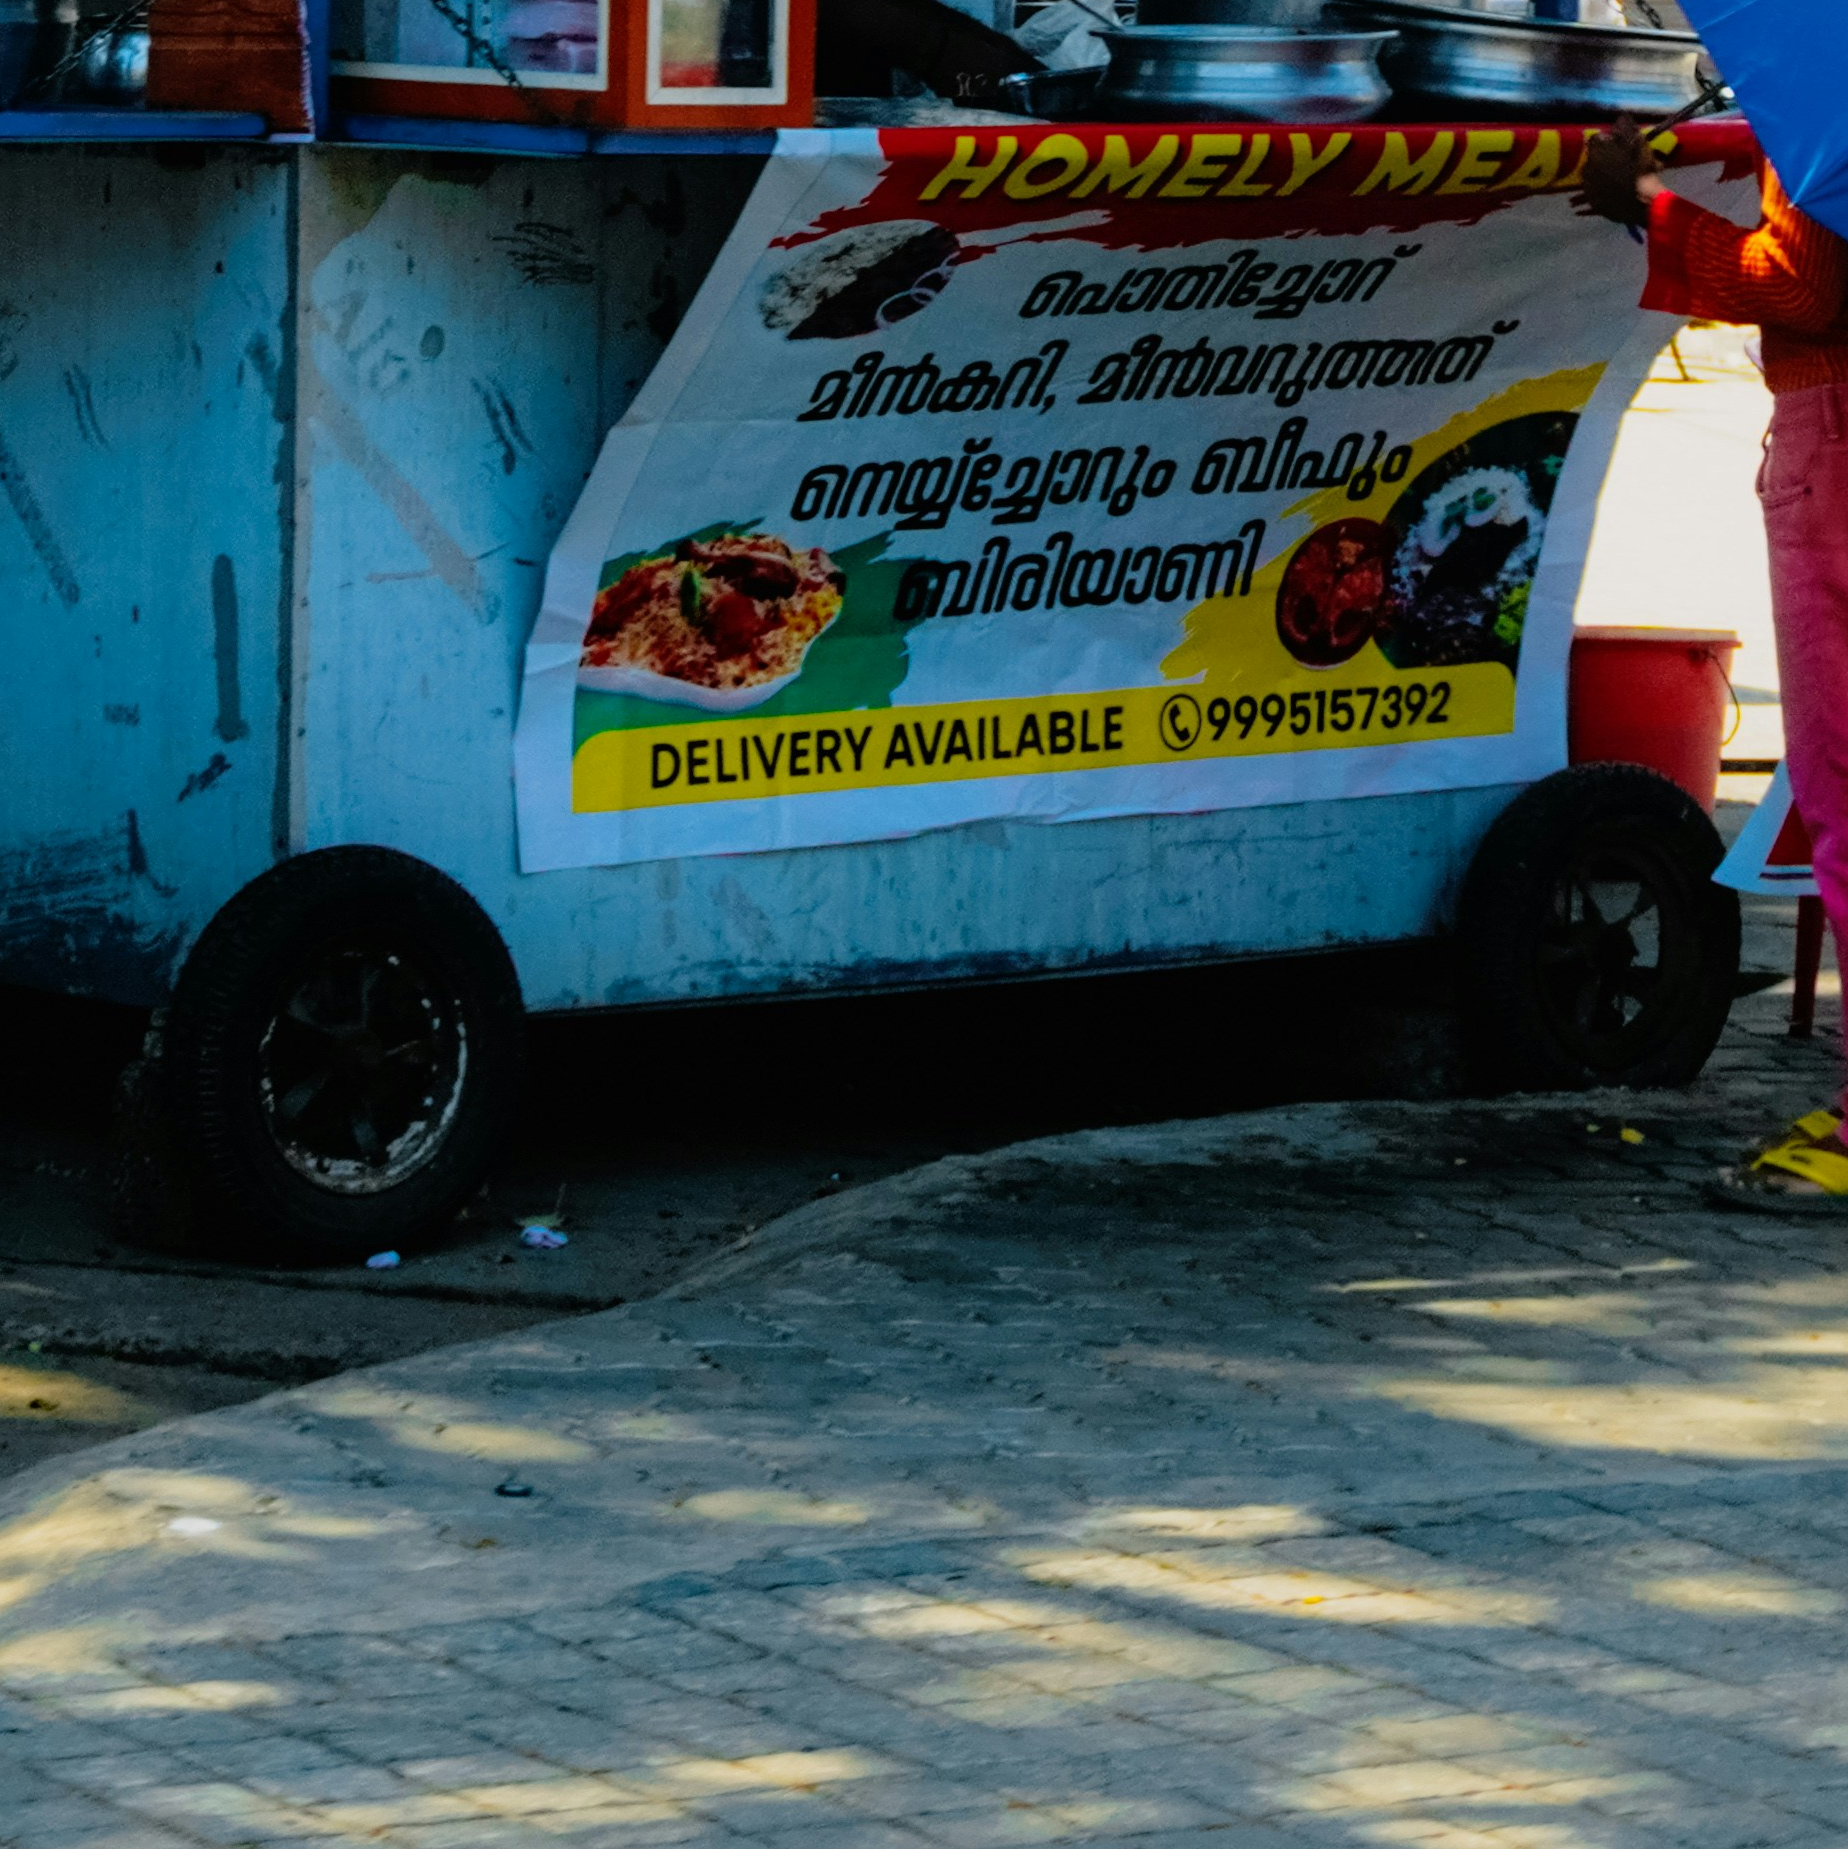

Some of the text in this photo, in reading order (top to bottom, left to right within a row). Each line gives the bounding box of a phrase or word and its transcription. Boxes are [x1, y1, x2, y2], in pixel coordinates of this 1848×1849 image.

[919, 131, 1351, 203] HOMELY
[649, 680, 1452, 790] DELIVERY AVAILABLE 9995157392
